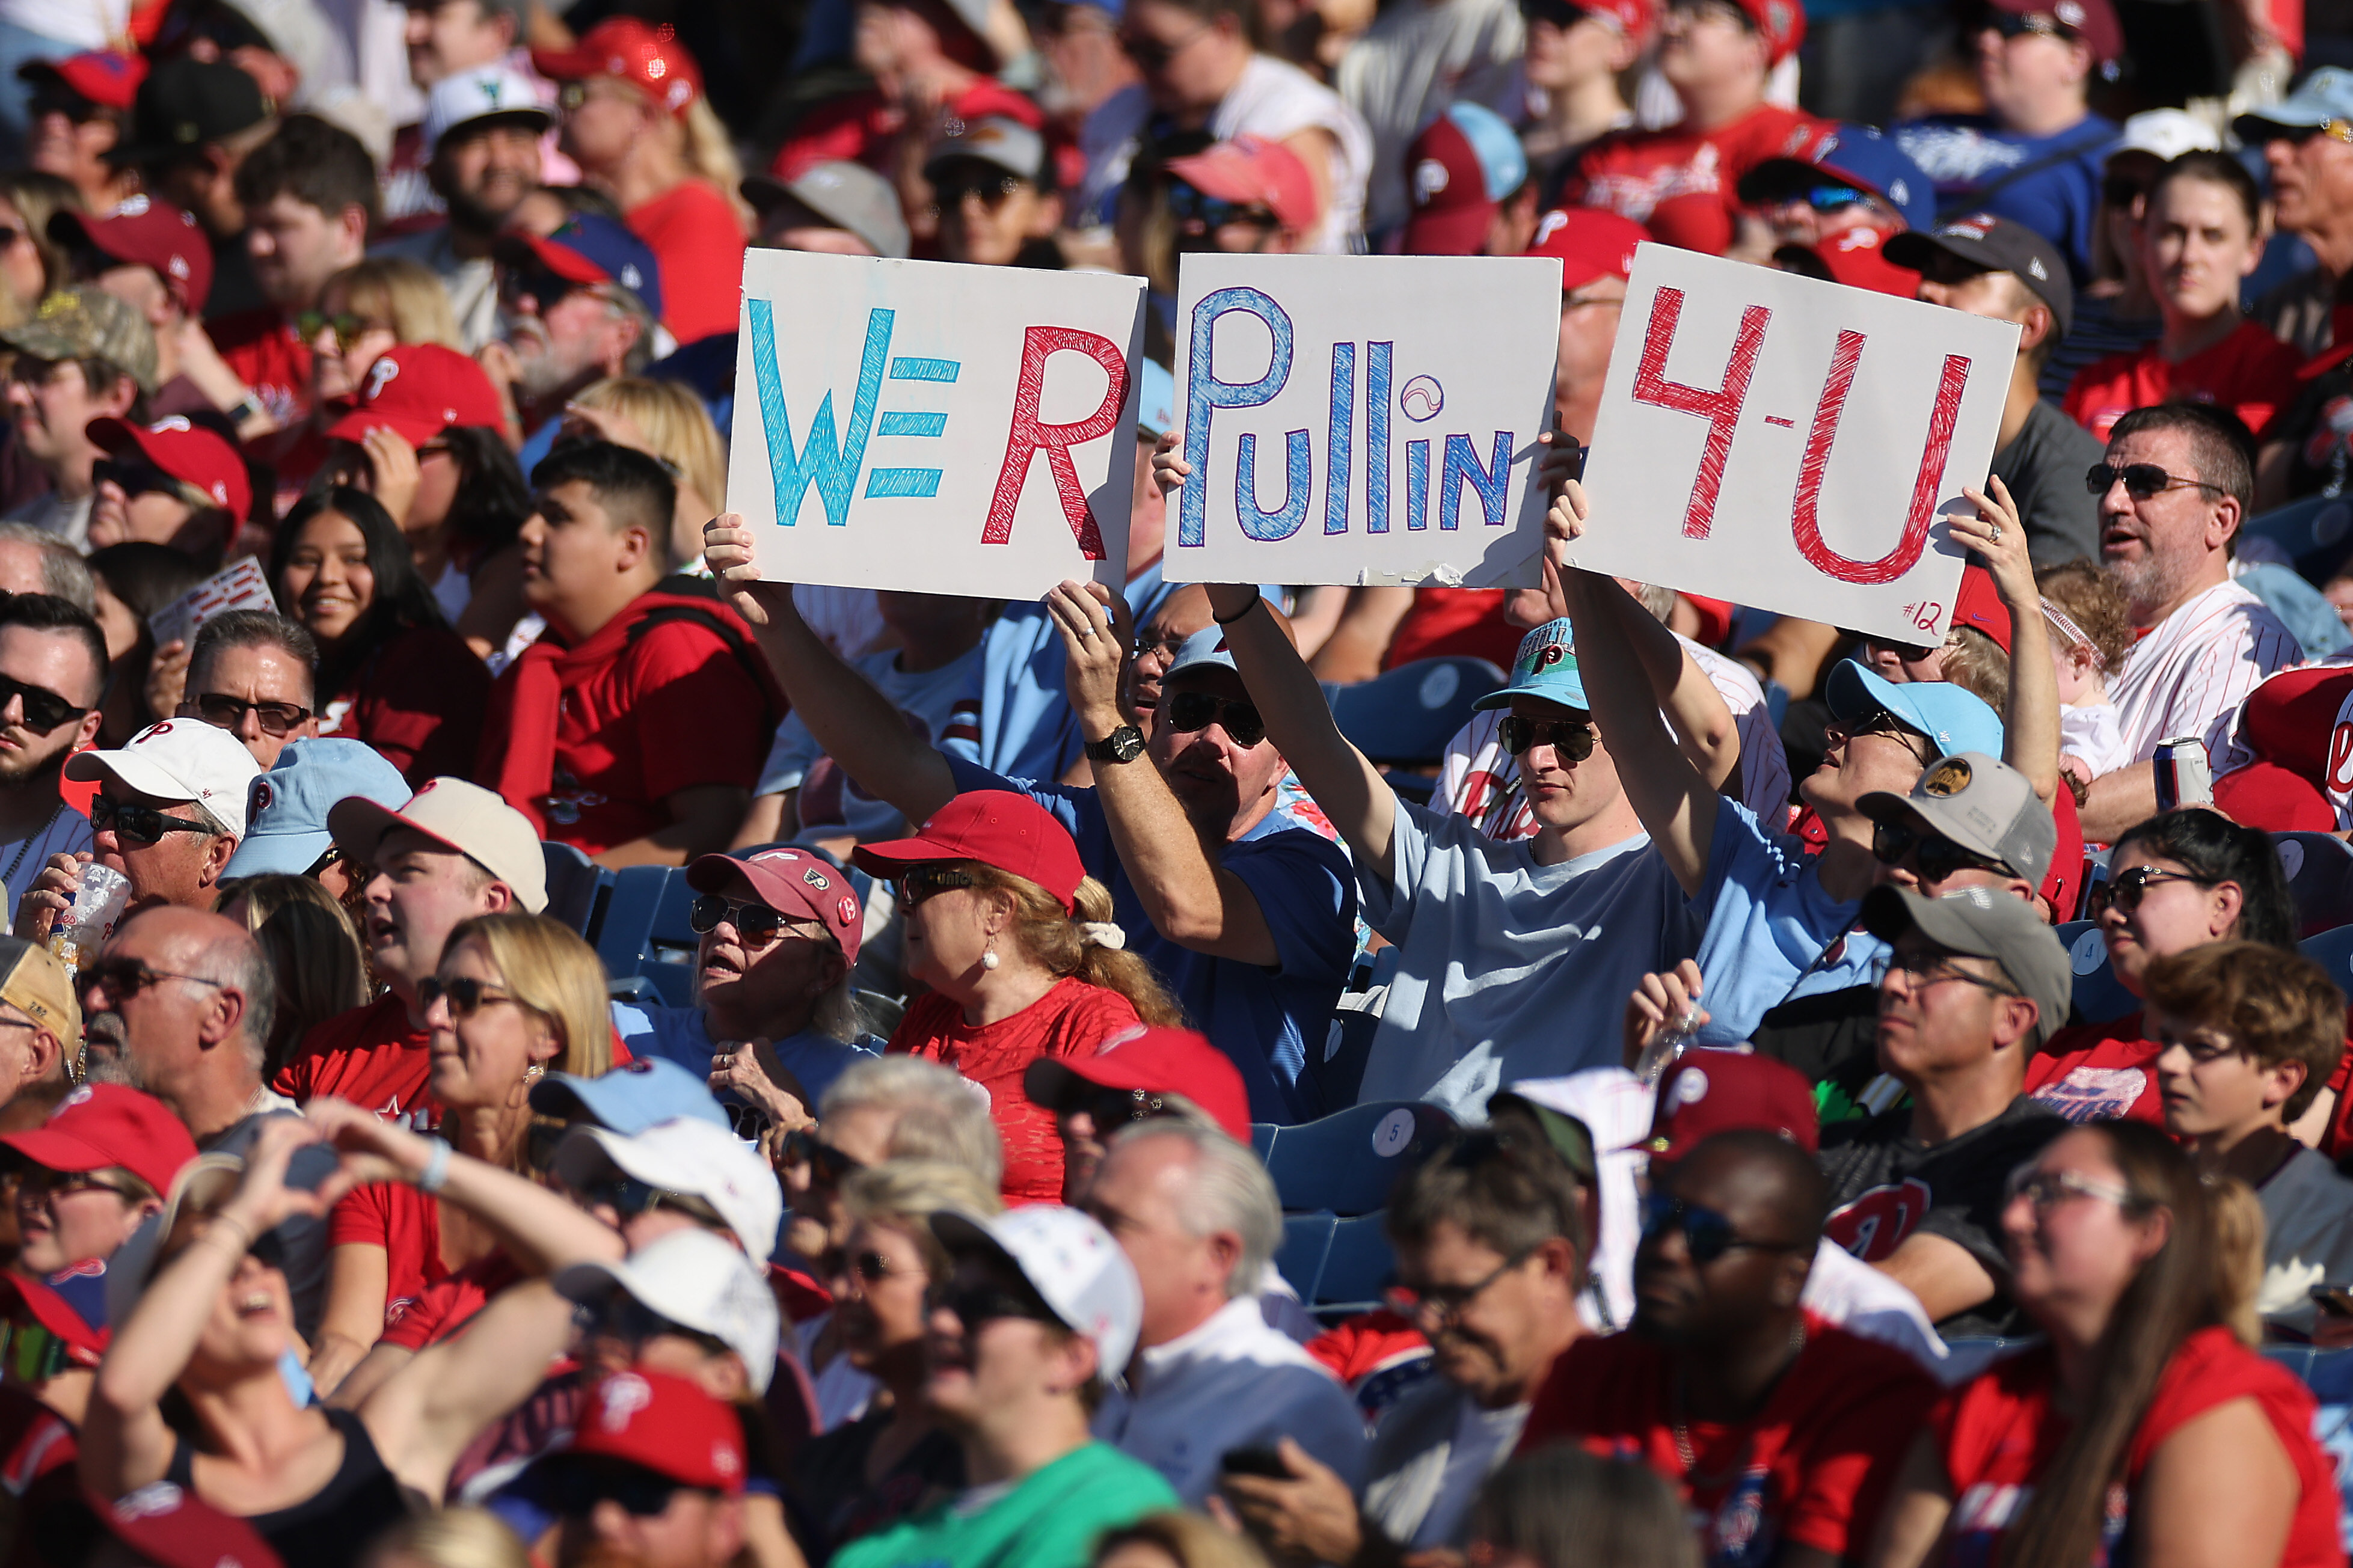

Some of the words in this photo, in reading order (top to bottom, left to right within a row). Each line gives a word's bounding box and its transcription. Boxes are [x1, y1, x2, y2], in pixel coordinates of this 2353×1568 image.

[747, 299, 962, 527] WE
[980, 325, 1132, 561] R
[1632, 285, 1972, 586] 4-U
[1902, 601, 1942, 637] #12
[2085, 943, 2094, 960] 4
[1389, 1124, 1400, 1142] 5
